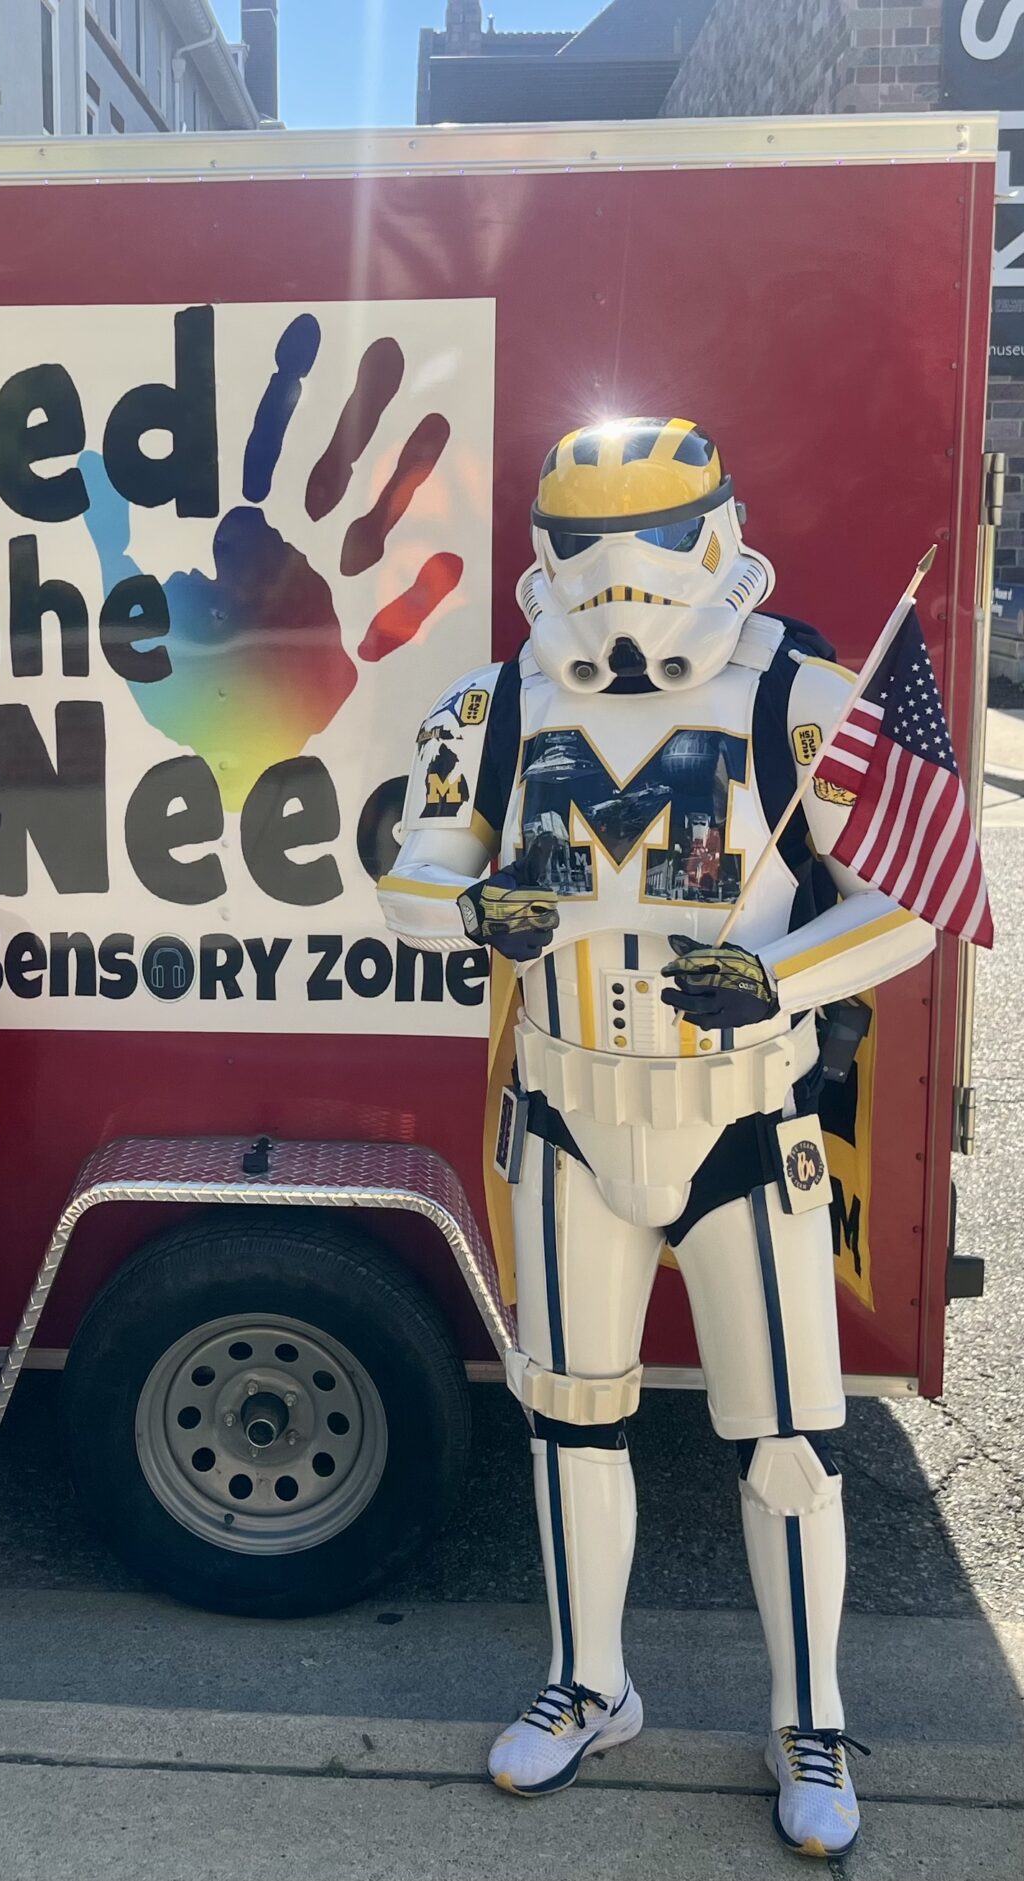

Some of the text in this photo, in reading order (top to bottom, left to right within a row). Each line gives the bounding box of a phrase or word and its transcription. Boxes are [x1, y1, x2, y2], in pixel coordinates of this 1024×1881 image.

[799, 730, 814, 739] HSJ
[801, 739, 815, 749] 52
[426, 772, 463, 804] M
[514, 724, 753, 911] M
